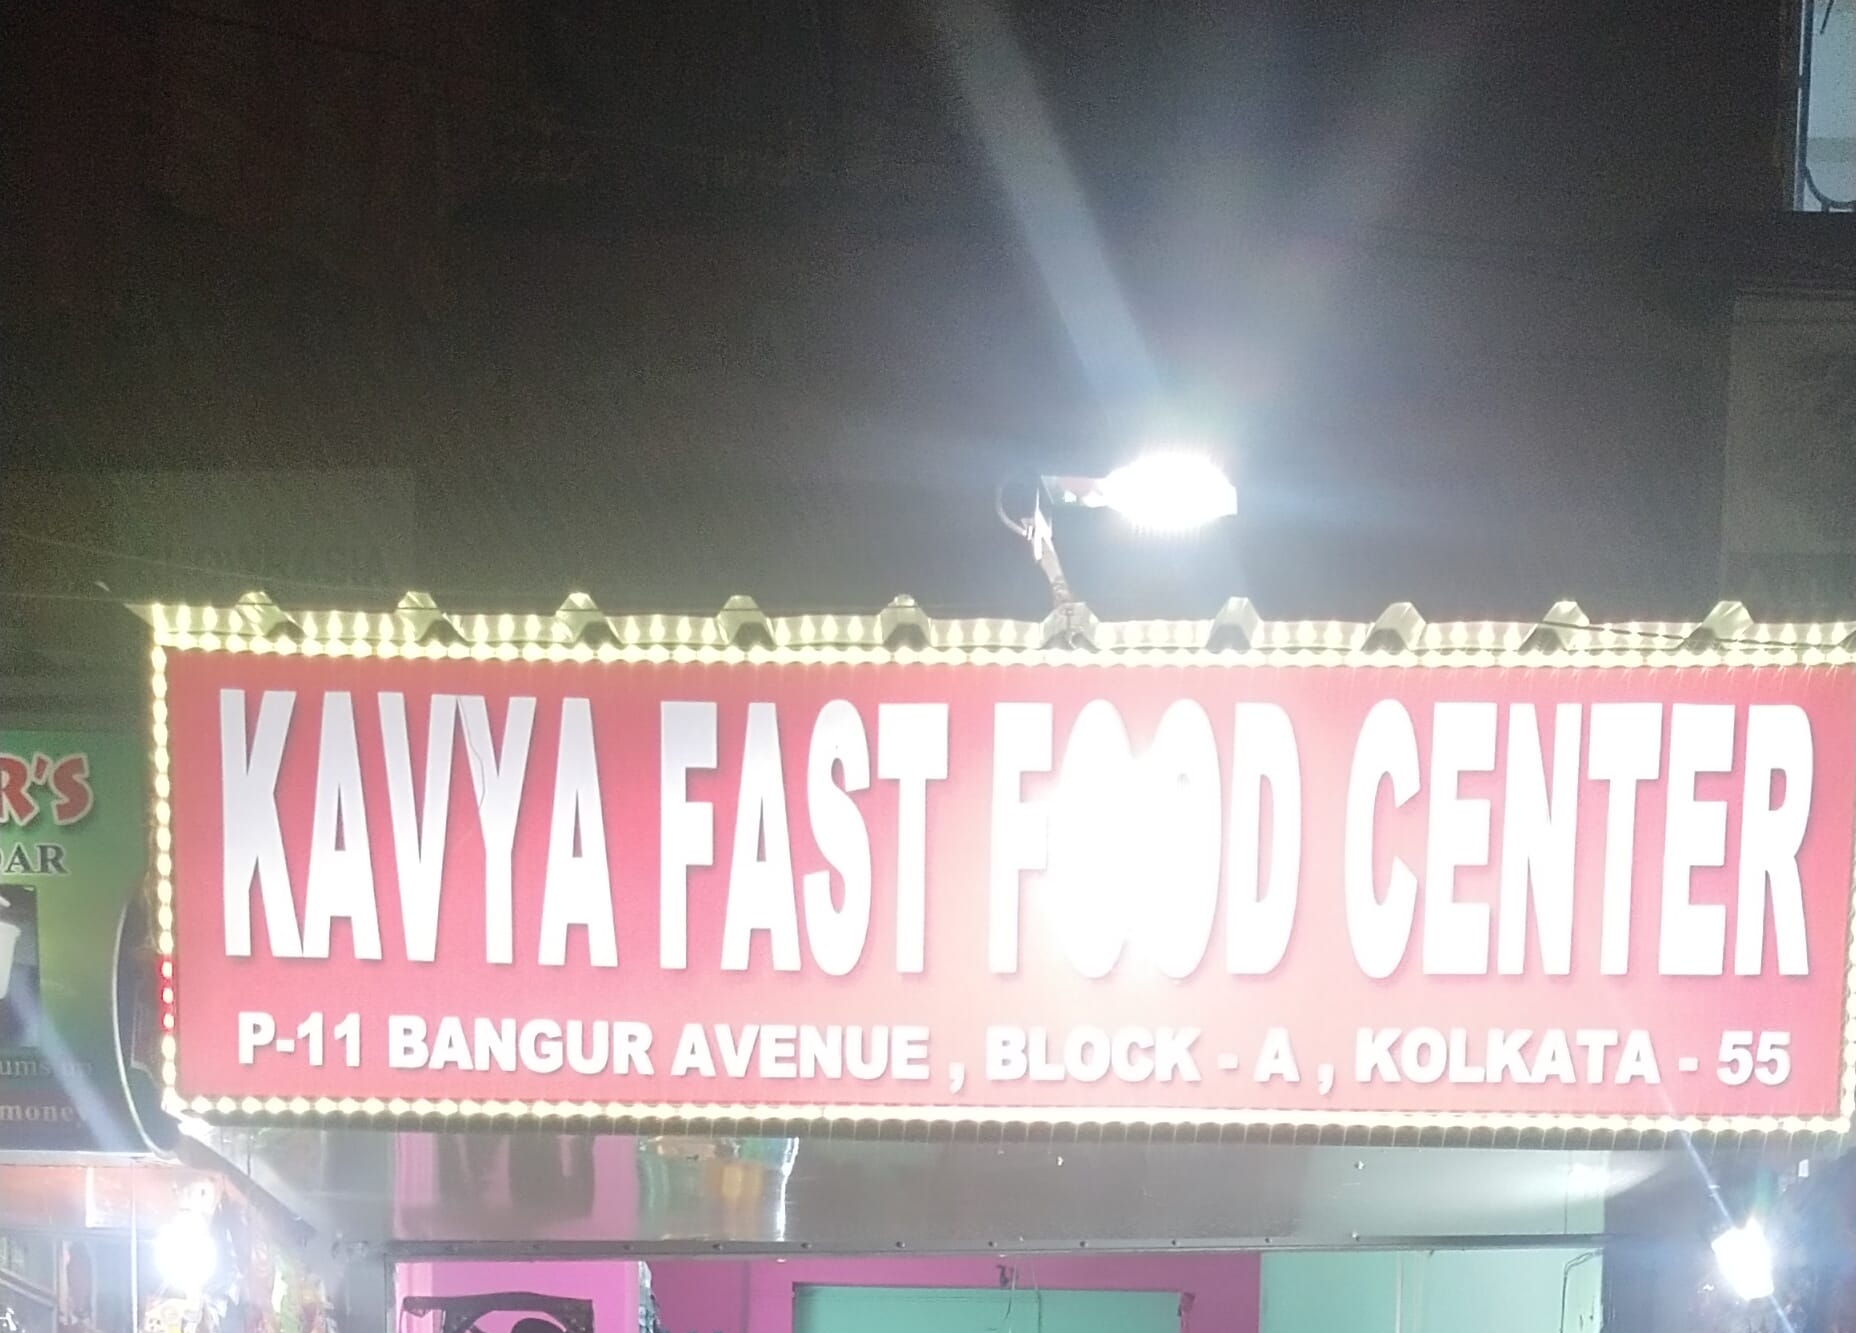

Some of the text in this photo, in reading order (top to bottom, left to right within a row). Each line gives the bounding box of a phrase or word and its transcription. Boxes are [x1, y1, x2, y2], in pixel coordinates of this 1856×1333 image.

[0, 842, 72, 876] AR
[220, 689, 1815, 978] KAVYA FAST FOOD CENTER
[238, 1011, 362, 1068] P-11
[388, 1016, 651, 1077] BANGUR
[671, 1022, 930, 1081] AVENUE
[986, 1026, 1201, 1083] BLOCK
[1253, 1028, 1301, 1083] A
[1355, 1028, 1662, 1085] KOLKATA
[1716, 1030, 1792, 1086] 55
